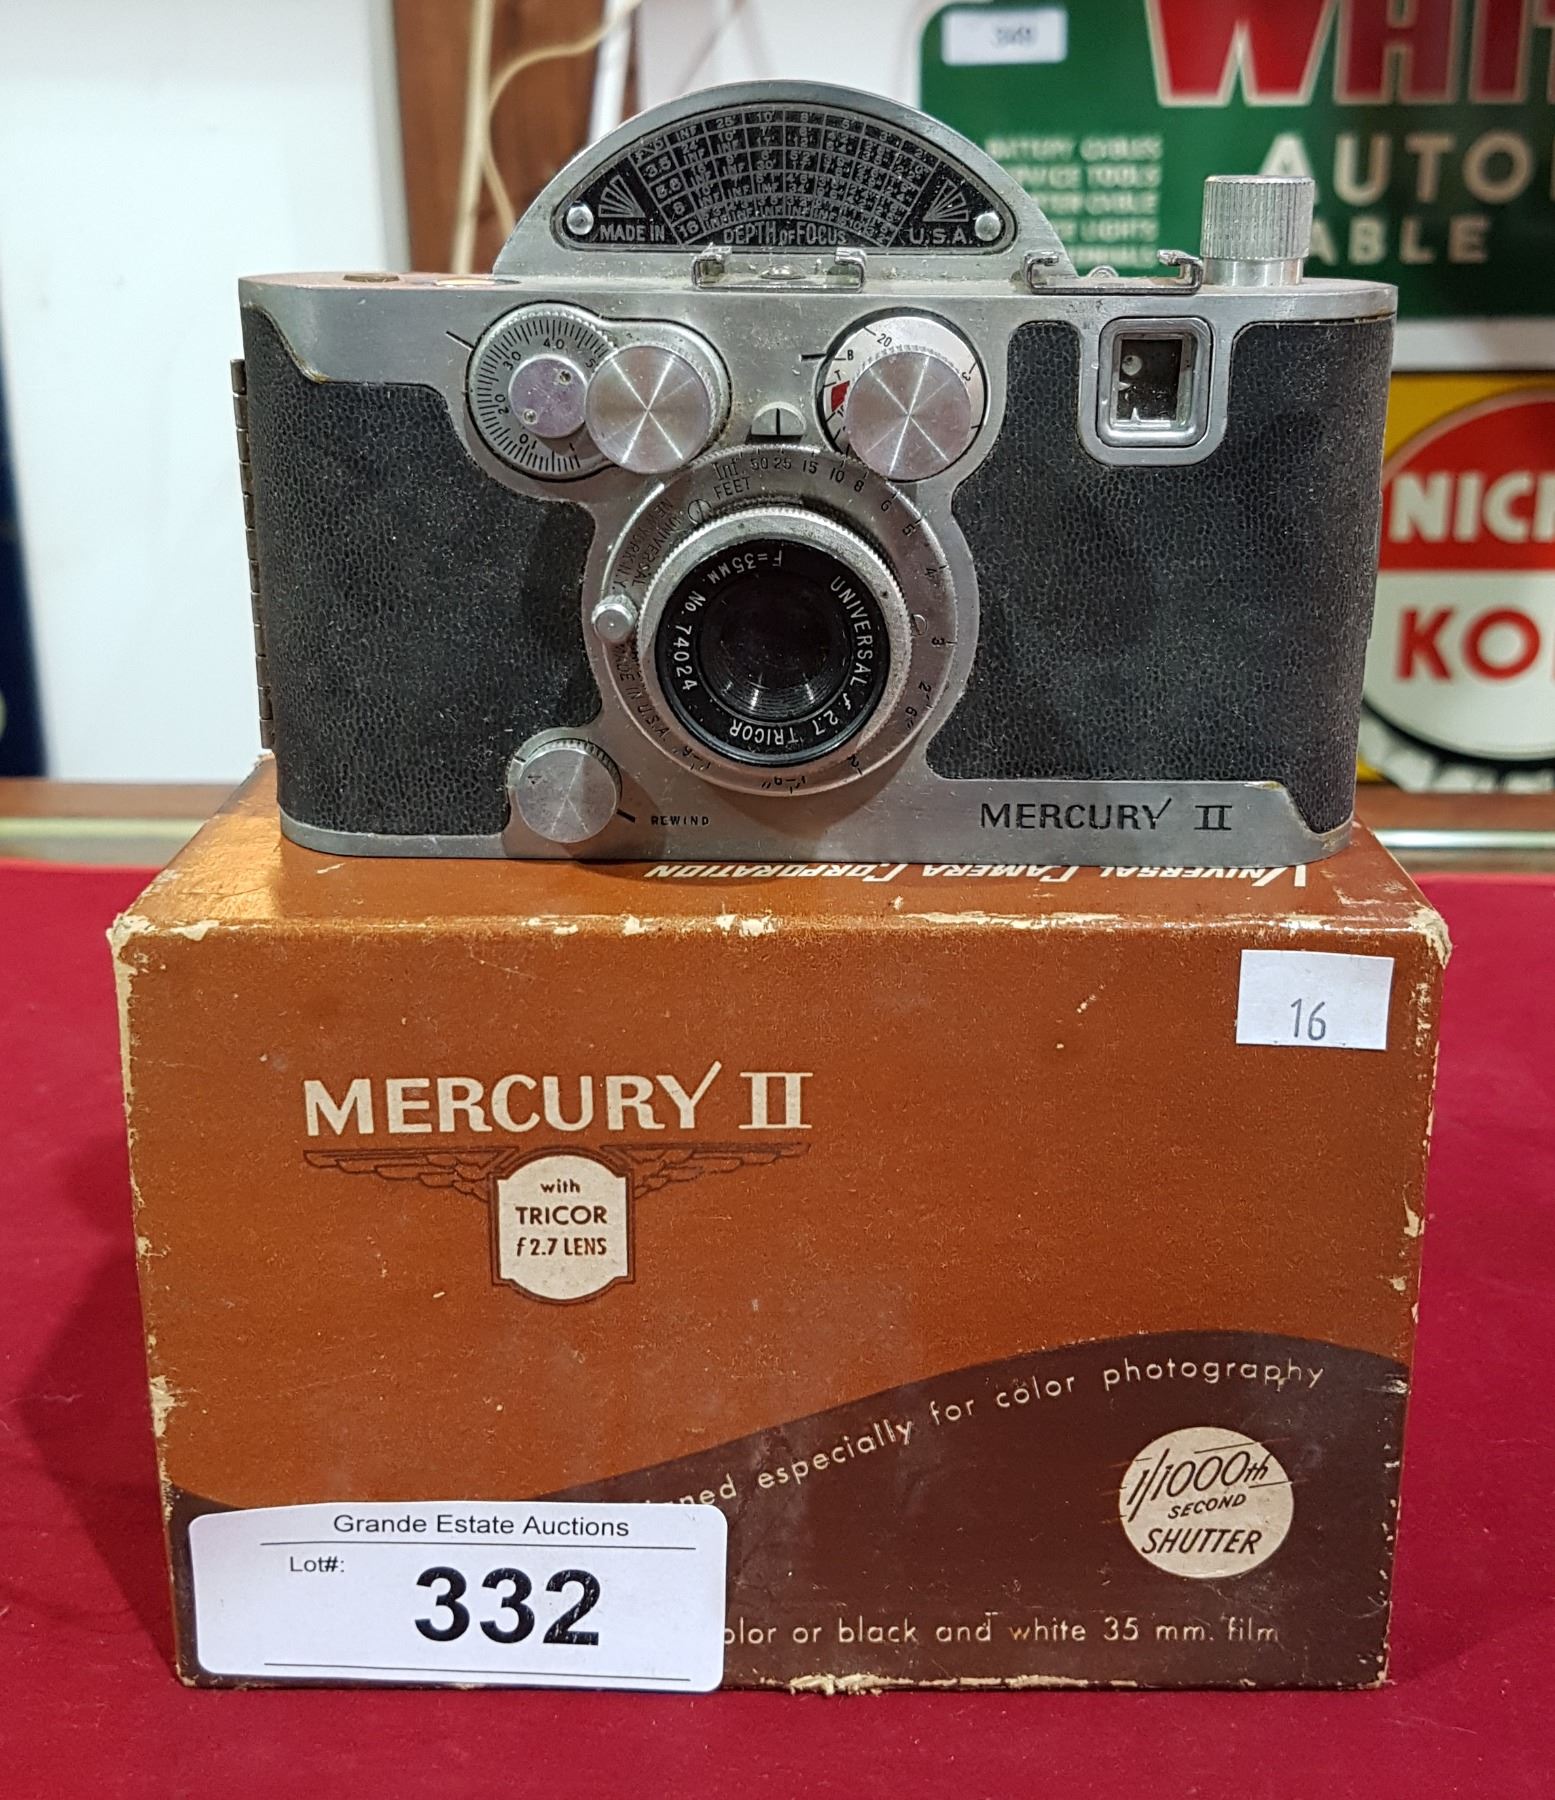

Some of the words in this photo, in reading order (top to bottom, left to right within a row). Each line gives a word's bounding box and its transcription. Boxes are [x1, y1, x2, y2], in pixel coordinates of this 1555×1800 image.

[1144, 0, 1555, 107] WHI
[1259, 129, 1555, 206] AUTO
[600, 224, 647, 242] MADE
[650, 224, 665, 242] IN
[723, 221, 777, 245] DEPTH
[796, 220, 847, 246] FOCUS
[909, 227, 973, 245] U.S.A.
[1309, 215, 1490, 265] ABLE
[543, 338, 565, 350] 40
[876, 332, 893, 348] 20
[502, 351, 522, 372] 30
[847, 349, 854, 361] B
[497, 393, 511, 417] 20
[519, 432, 538, 450] 10
[712, 476, 751, 500] FEET
[750, 457, 769, 471] 50
[774, 457, 793, 471] 25
[802, 459, 820, 475] 15
[829, 467, 846, 484] 10
[853, 479, 865, 493] 8
[881, 499, 893, 512] 6
[902, 523, 916, 536] 5
[931, 636, 946, 647] 3
[829, 575, 874, 687] UNIVERSAL
[672, 624, 698, 691] 74024
[1395, 606, 1555, 683] KO
[728, 718, 800, 745] TRICOR
[812, 709, 840, 736] 2.7
[650, 815, 710, 826] REWIND
[979, 797, 1173, 830] MERCURY
[1193, 804, 1233, 831] II
[643, 863, 908, 883] CORPORATION
[921, 863, 1080, 883] CAMERA
[1290, 997, 1326, 1041] 16
[302, 1060, 723, 1137] MERCURY
[738, 1071, 814, 1131] II
[539, 1178, 582, 1195] with
[515, 1205, 608, 1226] TRICOR
[530, 1237, 559, 1256] 2.7
[564, 1237, 608, 1256] LENS
[757, 1418, 914, 1490] especially
[929, 1399, 976, 1426] for
[995, 1374, 1077, 1409] color
[1102, 1357, 1324, 1391] photography
[1126, 1448, 1270, 1523] 1/1000th
[1167, 1492, 1248, 1520] SECOND
[333, 1513, 428, 1535] Grande
[436, 1514, 515, 1536] Estate
[523, 1515, 630, 1538] Auctions
[1140, 1527, 1262, 1555] SHUTTER
[289, 1555, 346, 1575] Lot#:
[413, 1565, 602, 1647] 332
[724, 1617, 778, 1645] olor
[791, 1624, 822, 1644] or
[838, 1617, 918, 1644] black
[935, 1616, 992, 1643] and
[1009, 1616, 1088, 1643] white
[1103, 1617, 1139, 1642] 35
[1154, 1621, 1214, 1643] mm.
[1226, 1616, 1280, 1642] film
